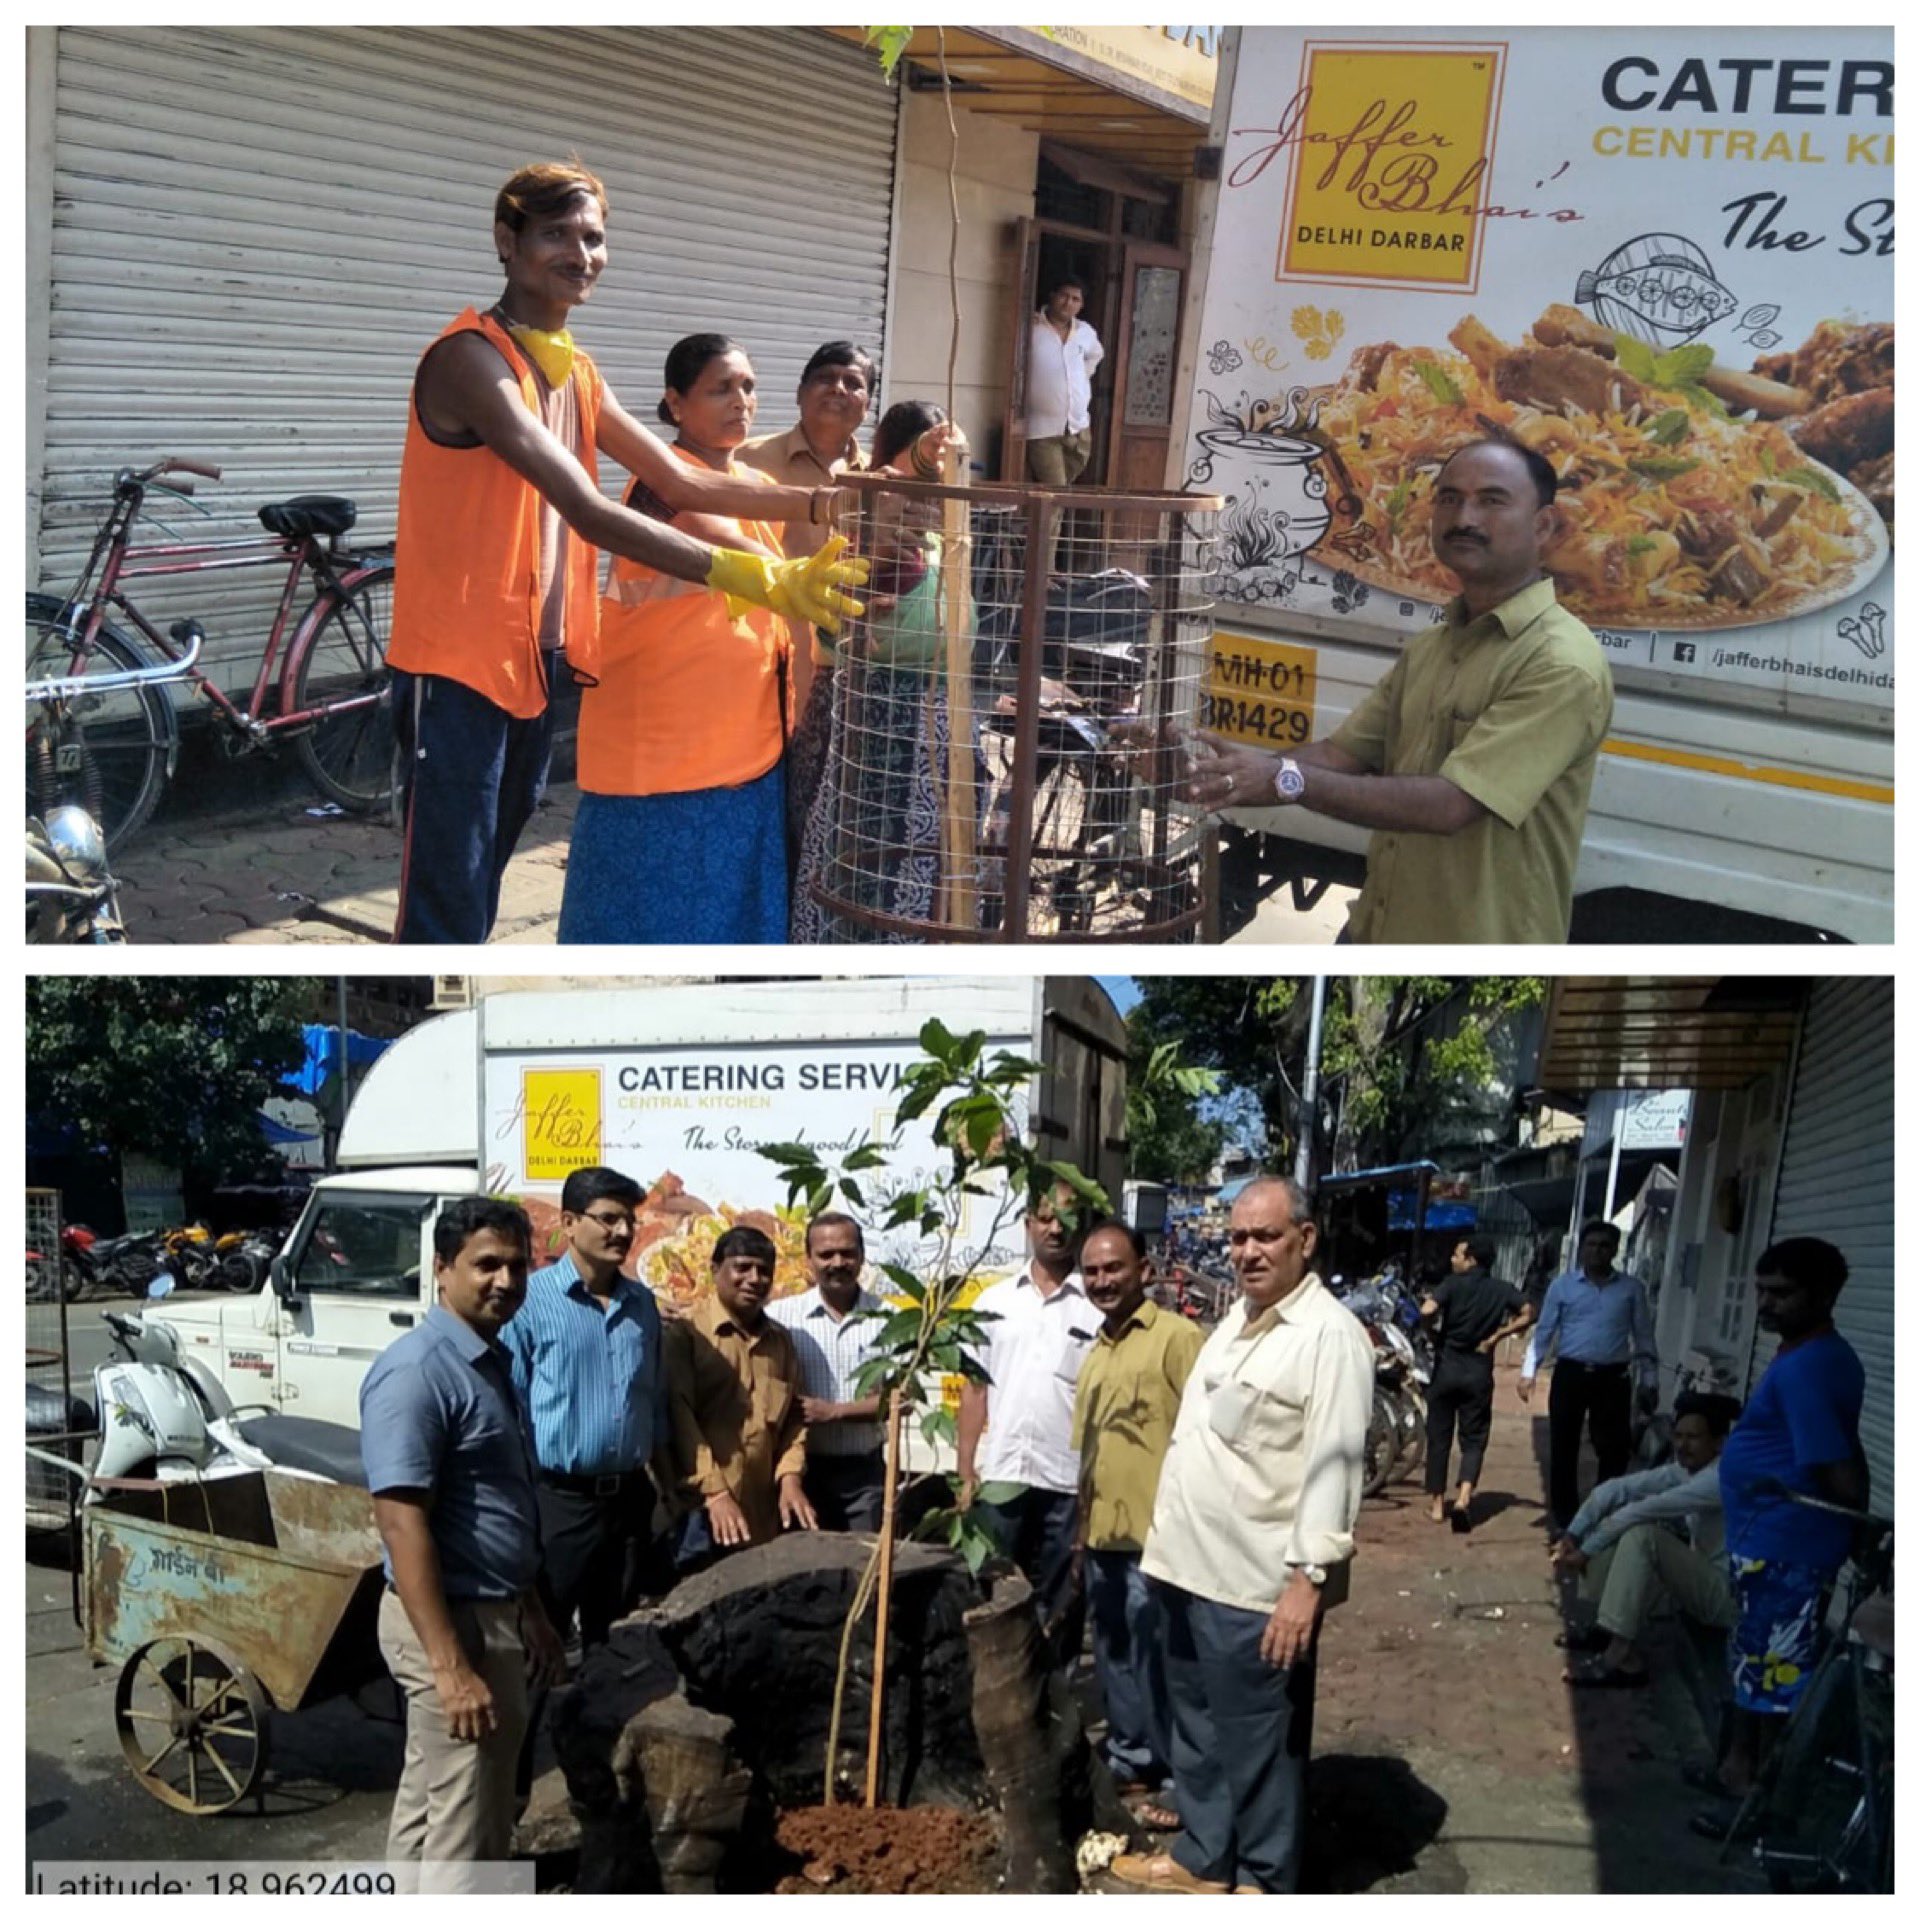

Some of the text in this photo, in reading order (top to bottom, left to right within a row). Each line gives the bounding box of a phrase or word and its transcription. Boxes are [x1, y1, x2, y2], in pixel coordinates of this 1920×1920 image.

[1602, 56, 1894, 116] CATER
[1228, 85, 1453, 191] Jaffer
[1592, 126, 1826, 164] CENTRAL
[1358, 153, 1584, 222] Bhai's
[1722, 191, 1826, 252] The
[1298, 226, 1465, 251] DELHI DARBAR
[618, 1063, 903, 1091] CATERING SERVI
[618, 1095, 771, 1109] CENTRAL KITCHEN
[683, 1125, 718, 1151] The
[723, 1125, 773, 1152] Stor
[528, 1156, 598, 1166] DELHI DARBAR
